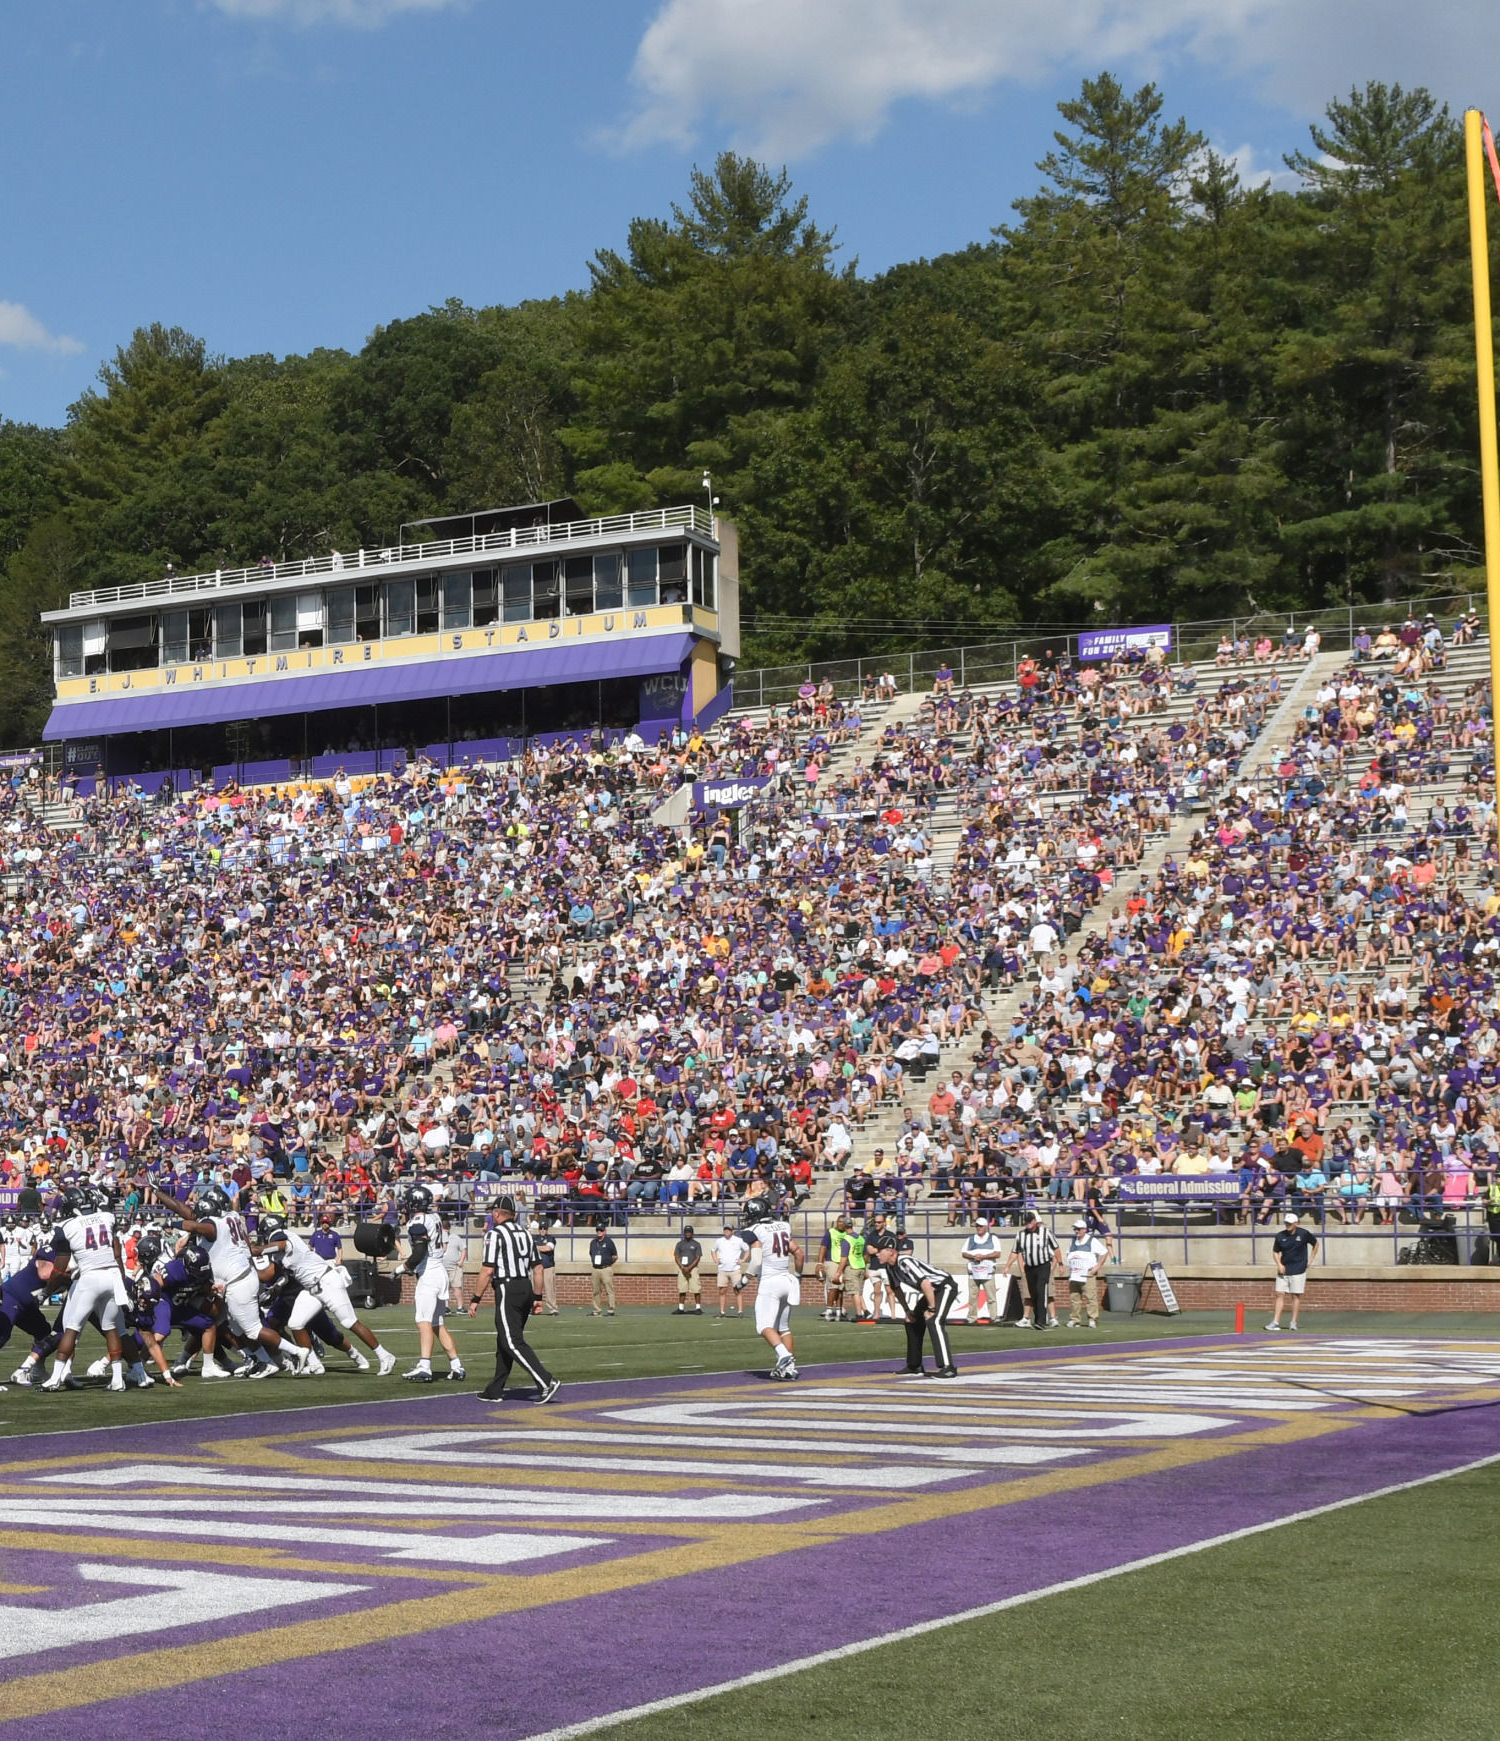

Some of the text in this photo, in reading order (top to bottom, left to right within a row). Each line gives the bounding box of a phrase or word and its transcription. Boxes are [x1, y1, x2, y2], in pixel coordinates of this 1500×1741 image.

[1094, 634, 1126, 646] FAMILY
[89, 612, 647, 693] E. J. WHITMIRE STADIUM
[489, 1182, 567, 1195] Visiting Team
[1136, 1180, 1240, 1195] General Admission
[85, 1223, 110, 1251] 44
[772, 1231, 791, 1258] 46
